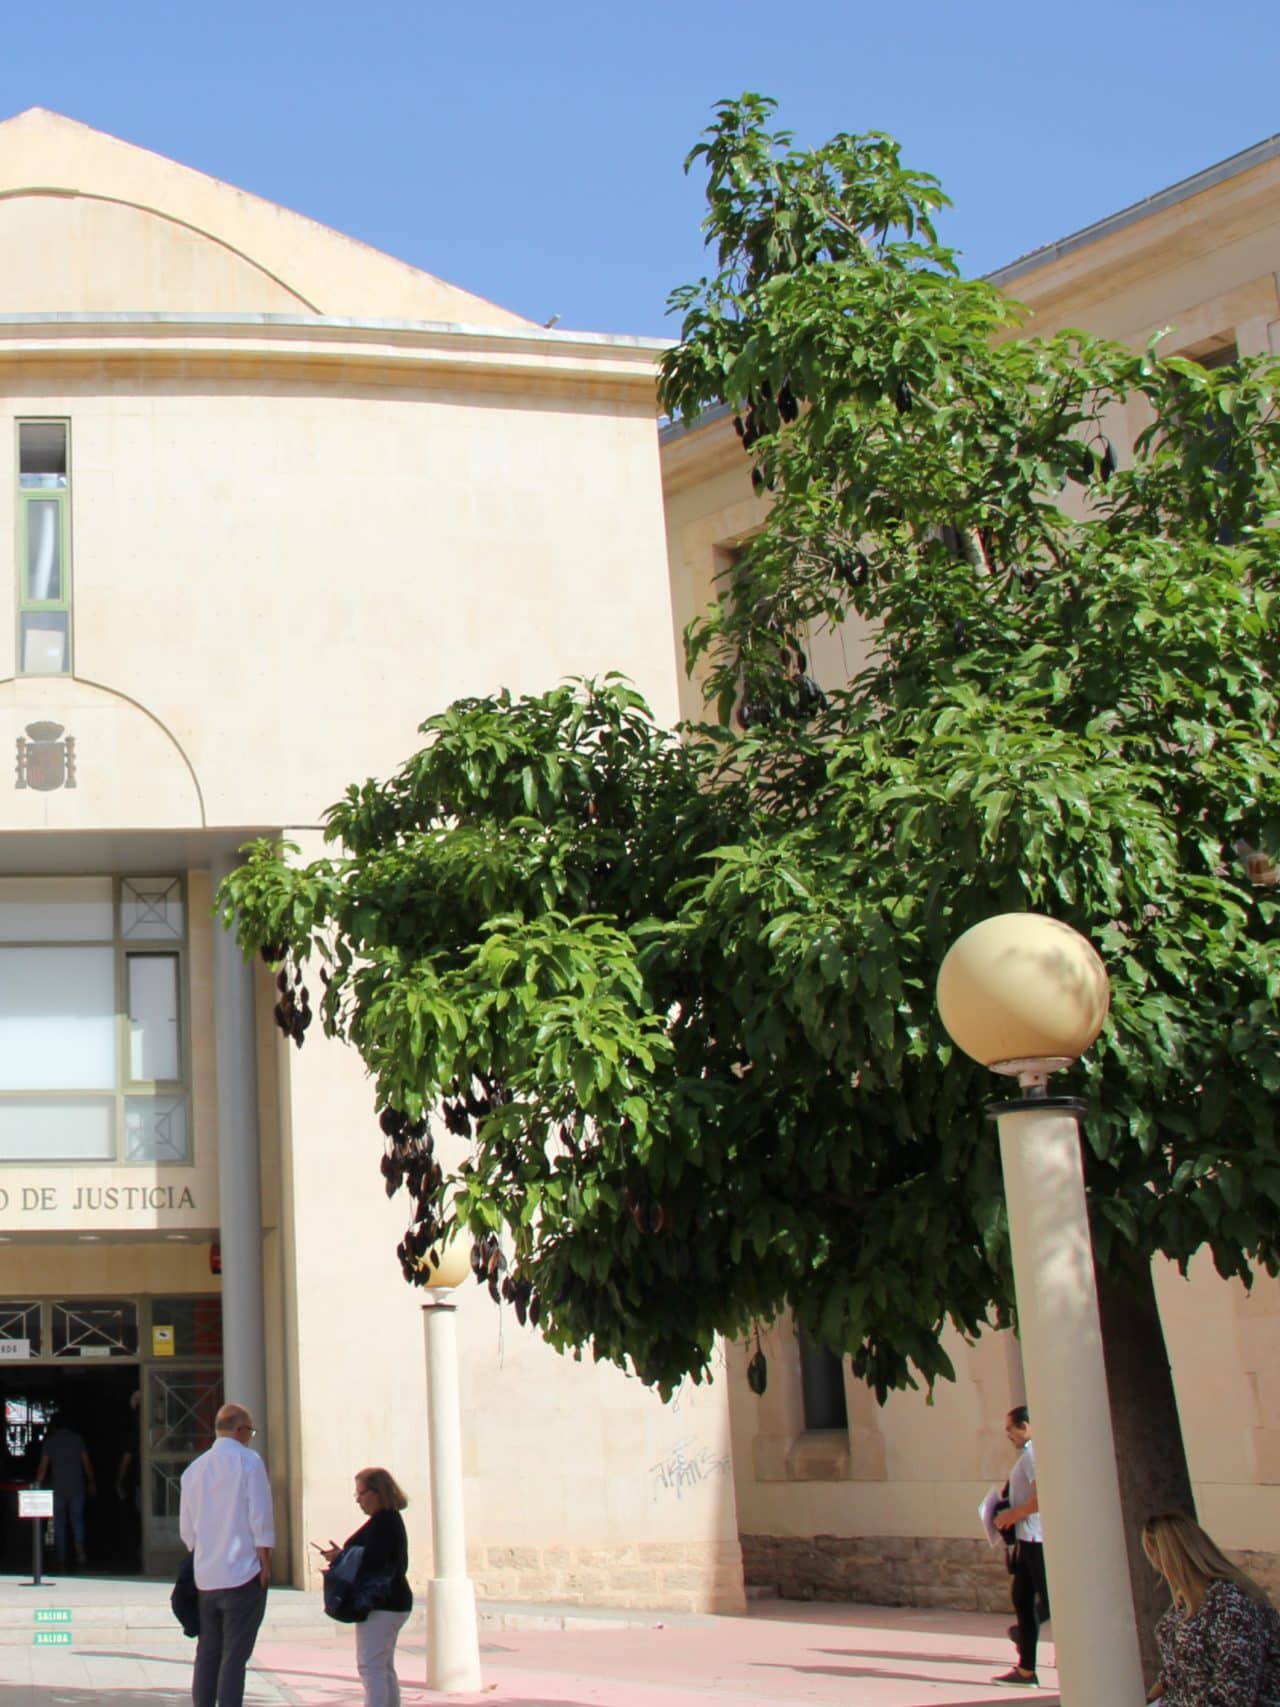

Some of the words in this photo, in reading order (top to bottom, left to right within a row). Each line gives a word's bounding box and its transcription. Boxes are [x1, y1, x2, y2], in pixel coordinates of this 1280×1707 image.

[21, 1187, 58, 1211] DE
[72, 1185, 197, 1211] JUSTICIA
[37, 1611, 69, 1621] SALIDA
[37, 1633, 69, 1643] SALIDA
